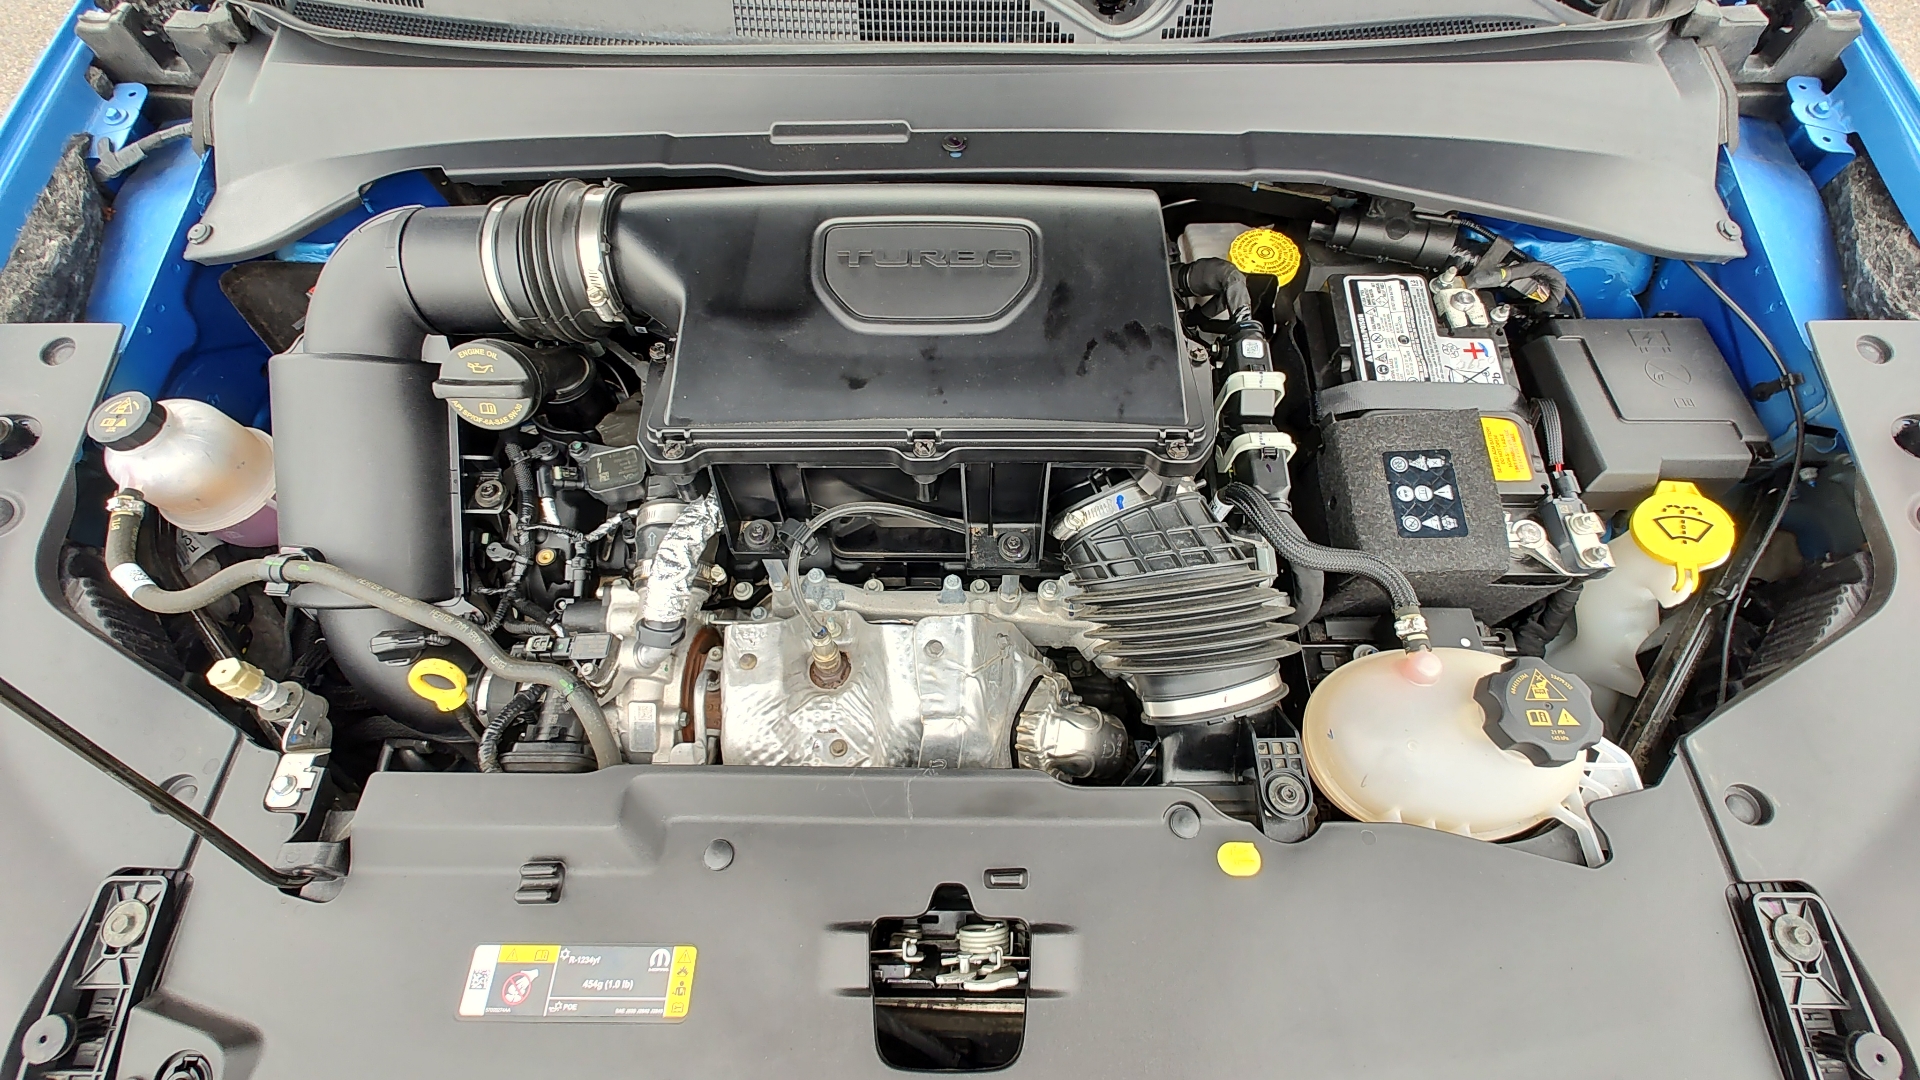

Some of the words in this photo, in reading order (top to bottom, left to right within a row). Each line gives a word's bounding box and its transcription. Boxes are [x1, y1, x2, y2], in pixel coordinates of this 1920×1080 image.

[837, 248, 1022, 268] TURBO
[458, 348, 485, 359] ENGINE
[486, 350, 498, 360] OIL
[451, 400, 464, 411] API
[508, 403, 523, 420] 5W-30
[429, 609, 454, 624] HEATER
[489, 654, 507, 670] HEATER
[568, 956, 601, 966] R-1234yf
[582, 980, 603, 991] 454g
[604, 980, 620, 991] (1.0
[622, 980, 634, 990] lb)
